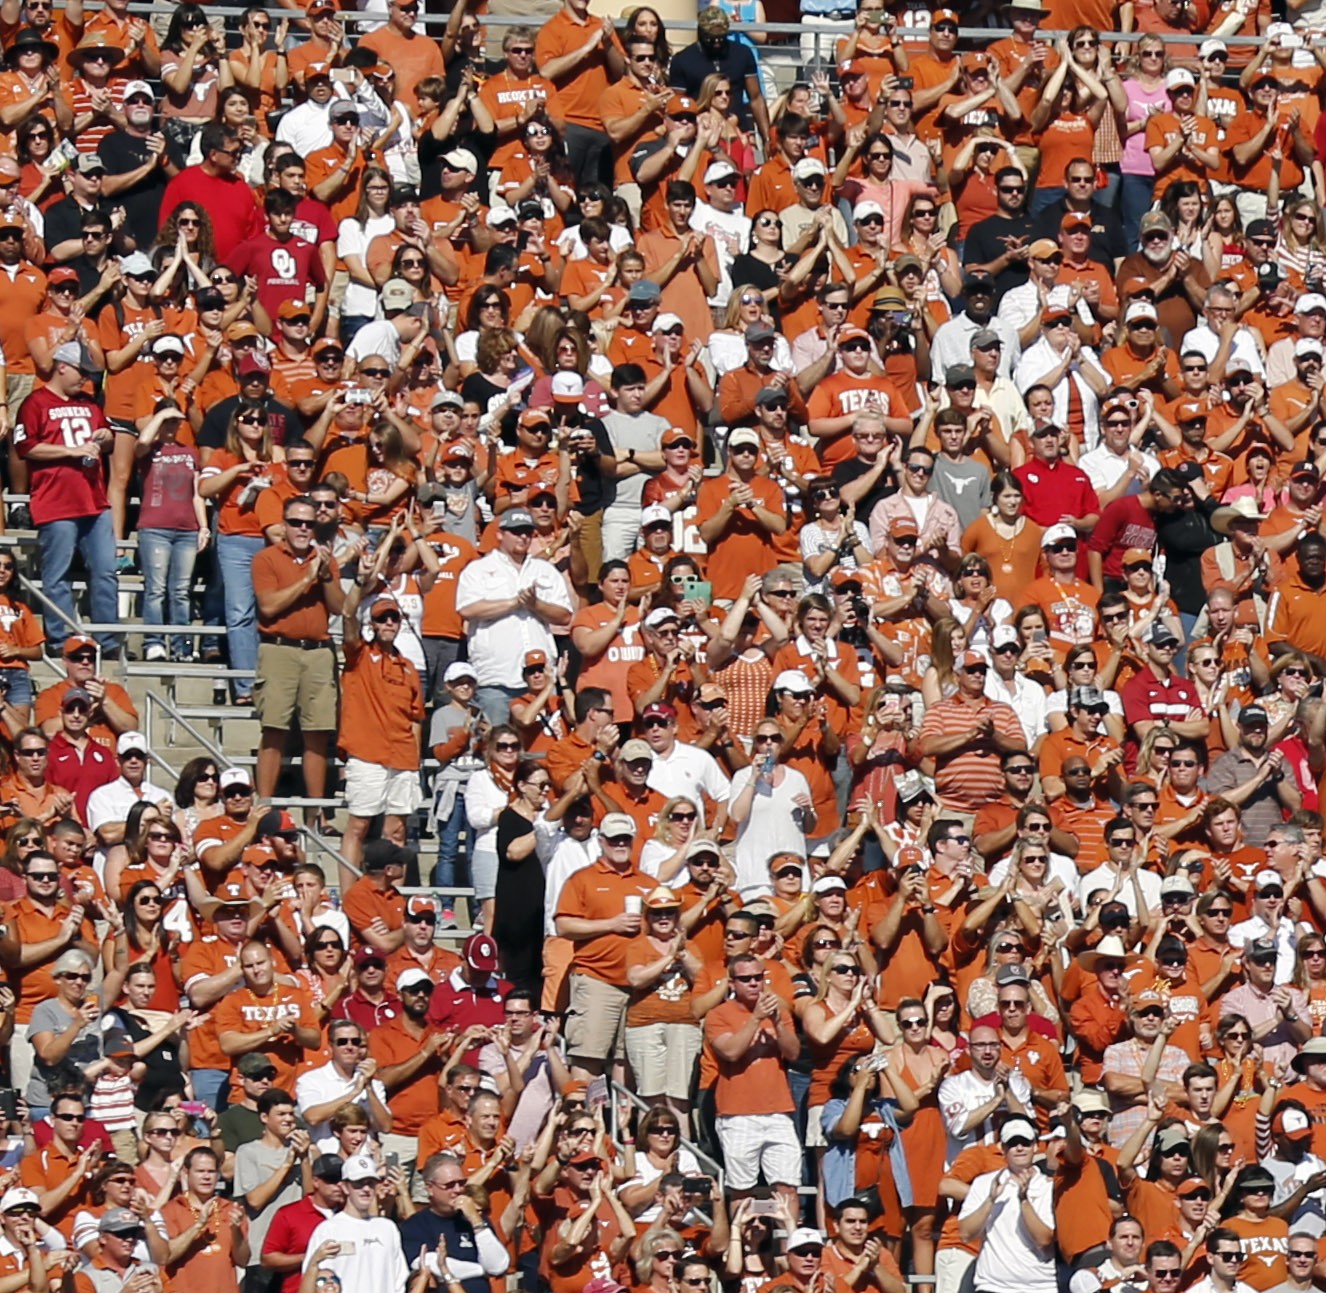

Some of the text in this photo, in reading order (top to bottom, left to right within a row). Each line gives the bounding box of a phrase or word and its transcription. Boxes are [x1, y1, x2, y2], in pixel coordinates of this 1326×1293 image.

[272, 249, 296, 278] OU
[48, 407, 92, 420] SOONERS
[60, 417, 92, 448] 12
[226, 884, 240, 896] T
[241, 1003, 301, 1021] TEXAS
